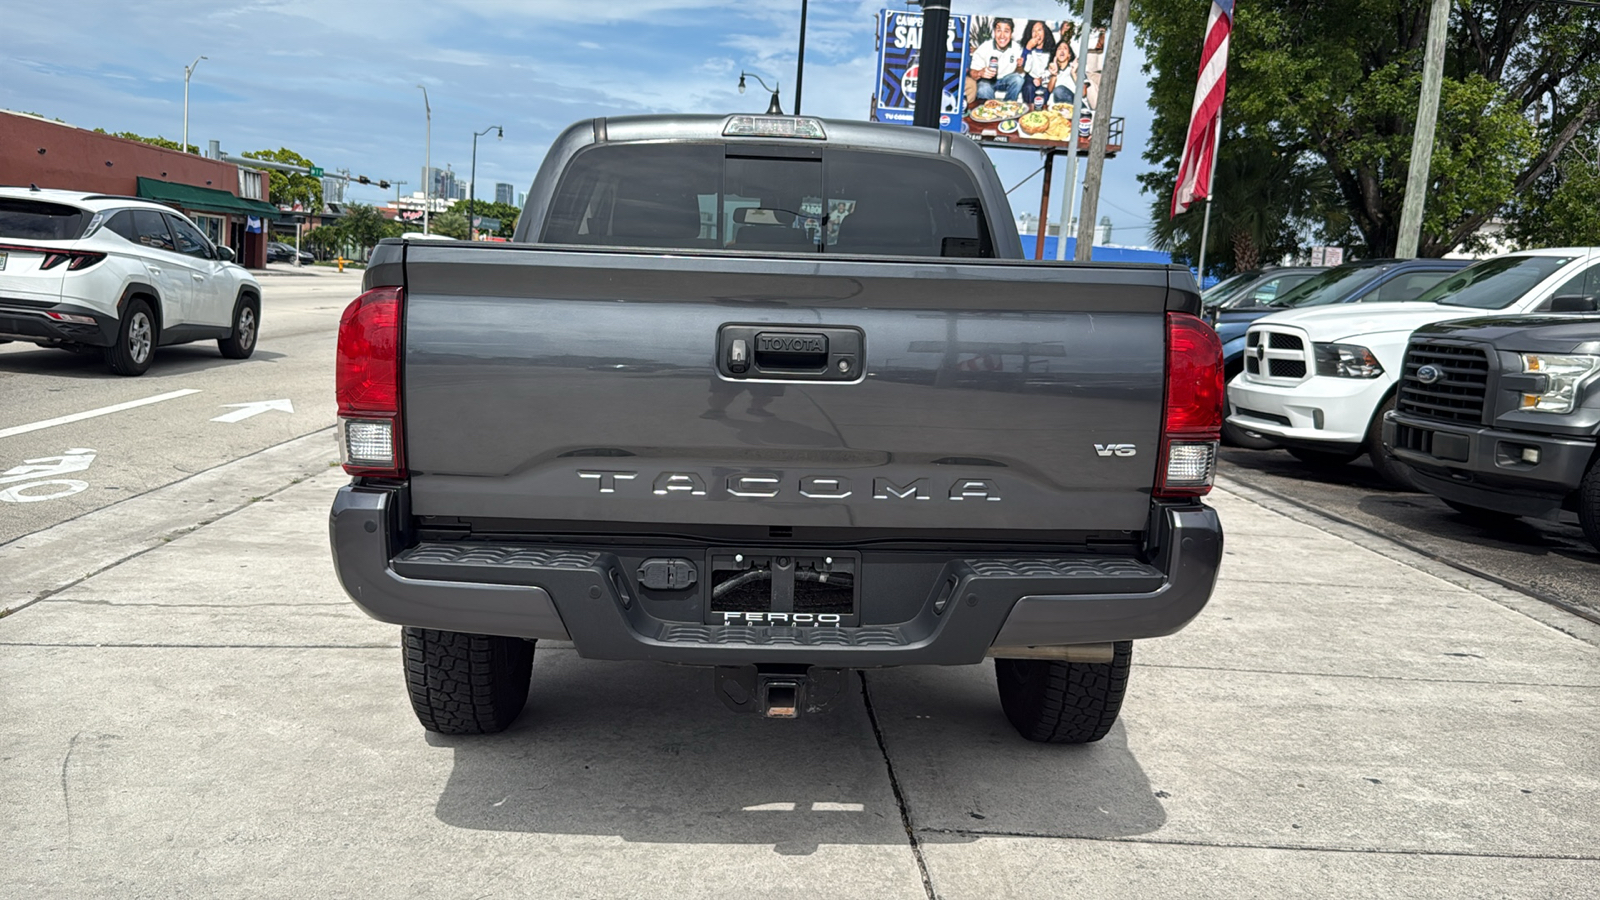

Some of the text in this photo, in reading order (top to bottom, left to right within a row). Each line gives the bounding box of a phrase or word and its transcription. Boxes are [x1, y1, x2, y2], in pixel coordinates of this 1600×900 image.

[762, 337, 822, 351] TOYOTA
[1093, 443, 1136, 457] V6
[577, 469, 1001, 501] TACOMA
[723, 611, 840, 622] FERCO
